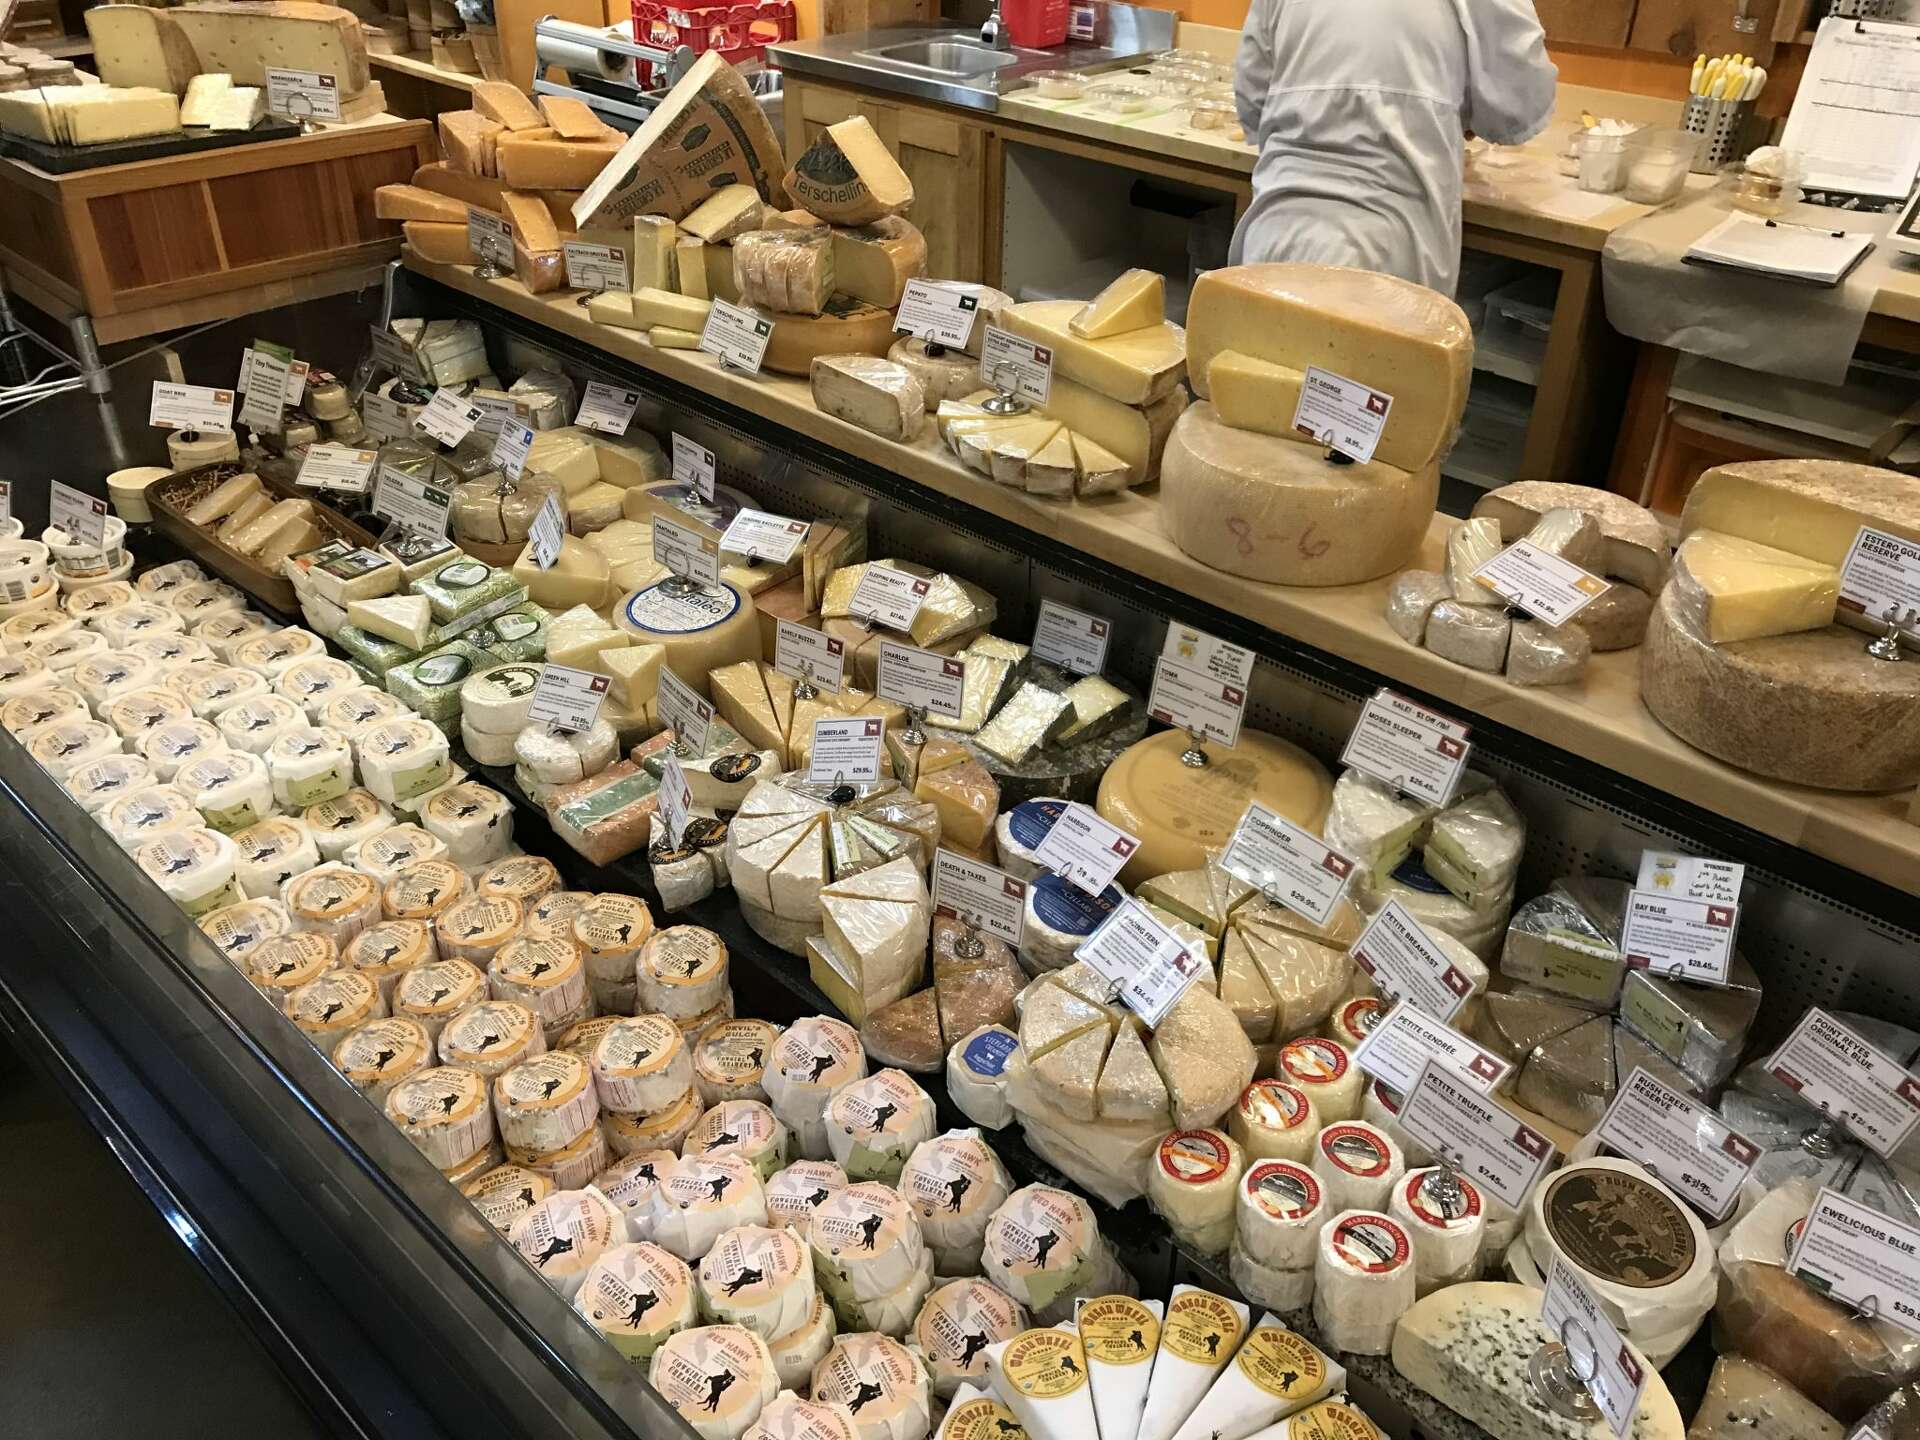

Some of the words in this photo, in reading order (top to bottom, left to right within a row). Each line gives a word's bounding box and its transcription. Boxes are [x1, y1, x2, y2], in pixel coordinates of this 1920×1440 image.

[713, 307, 744, 325] TERSCHELLING
[1318, 380, 1342, 395] GEORGE
[1861, 543, 1902, 562] RESERVE
[1865, 534, 1899, 552] ESTERO
[867, 570, 890, 582] SLEEPING
[888, 577, 906, 587] BEAUTY
[883, 650, 910, 663] CHARLOE
[543, 672, 559, 680] GREEN
[817, 728, 848, 736] CUMBERLAND
[1367, 710, 1392, 726] MOSES
[1391, 721, 1423, 740] SLEEPER
[1065, 813, 1092, 833] HARBISON
[1249, 814, 1292, 845] COPPINGER
[939, 859, 960, 873] DEATH
[960, 867, 966, 875] &
[966, 869, 987, 883] TAXES
[1634, 902, 1648, 911] BAY
[1648, 904, 1667, 915] BLUE
[1142, 931, 1161, 948] FERN
[1382, 909, 1407, 935] PETITE
[1400, 930, 1441, 969] BREAKFAST
[1394, 1013, 1426, 1035] PETITE
[820, 1023, 834, 1037] RED
[831, 1034, 851, 1055] HAWK
[1807, 1023, 1852, 1055] ORIGINAL
[1848, 1050, 1875, 1072] BLUE
[1813, 1017, 1844, 1039] POINT
[1839, 1034, 1872, 1059] REYES
[1426, 1072, 1456, 1096] PETITE
[1455, 1092, 1494, 1123] TRUFFLE
[1632, 1082, 1673, 1112] RESERVE
[1636, 1075, 1662, 1096] RUSH
[1660, 1090, 1693, 1115] CREEK
[941, 1144, 954, 1154] RED
[953, 1147, 979, 1168] HAWK
[482, 1175, 519, 1190] GULCH
[804, 1169, 833, 1180] HAWK
[580, 1201, 591, 1217] RED
[848, 1190, 863, 1200] RED
[864, 1192, 891, 1206] HAWK
[1032, 1194, 1049, 1208] RED
[1047, 1205, 1073, 1225] HAWK
[585, 1218, 598, 1243] HAWK
[1820, 1205, 1887, 1243] EWELICIOUS
[1886, 1234, 1917, 1256] BLUE
[771, 1235, 782, 1254] RED
[638, 1248, 655, 1265] RED
[653, 1262, 675, 1287] HAWK
[775, 1253, 786, 1273] HAWK
[601, 1272, 633, 1299] COWGIRL
[970, 1287, 984, 1303] RED
[983, 1301, 1008, 1329] HAWK
[710, 1331, 727, 1345] RED
[726, 1341, 751, 1362] HAWK
[672, 1357, 707, 1382] COWGIRL
[879, 1342, 890, 1360] RED
[887, 1357, 905, 1383] HAWK
[667, 1364, 704, 1395] CREAMERY
[797, 1405, 812, 1420] RED
[812, 1417, 840, 1440] HAWK
